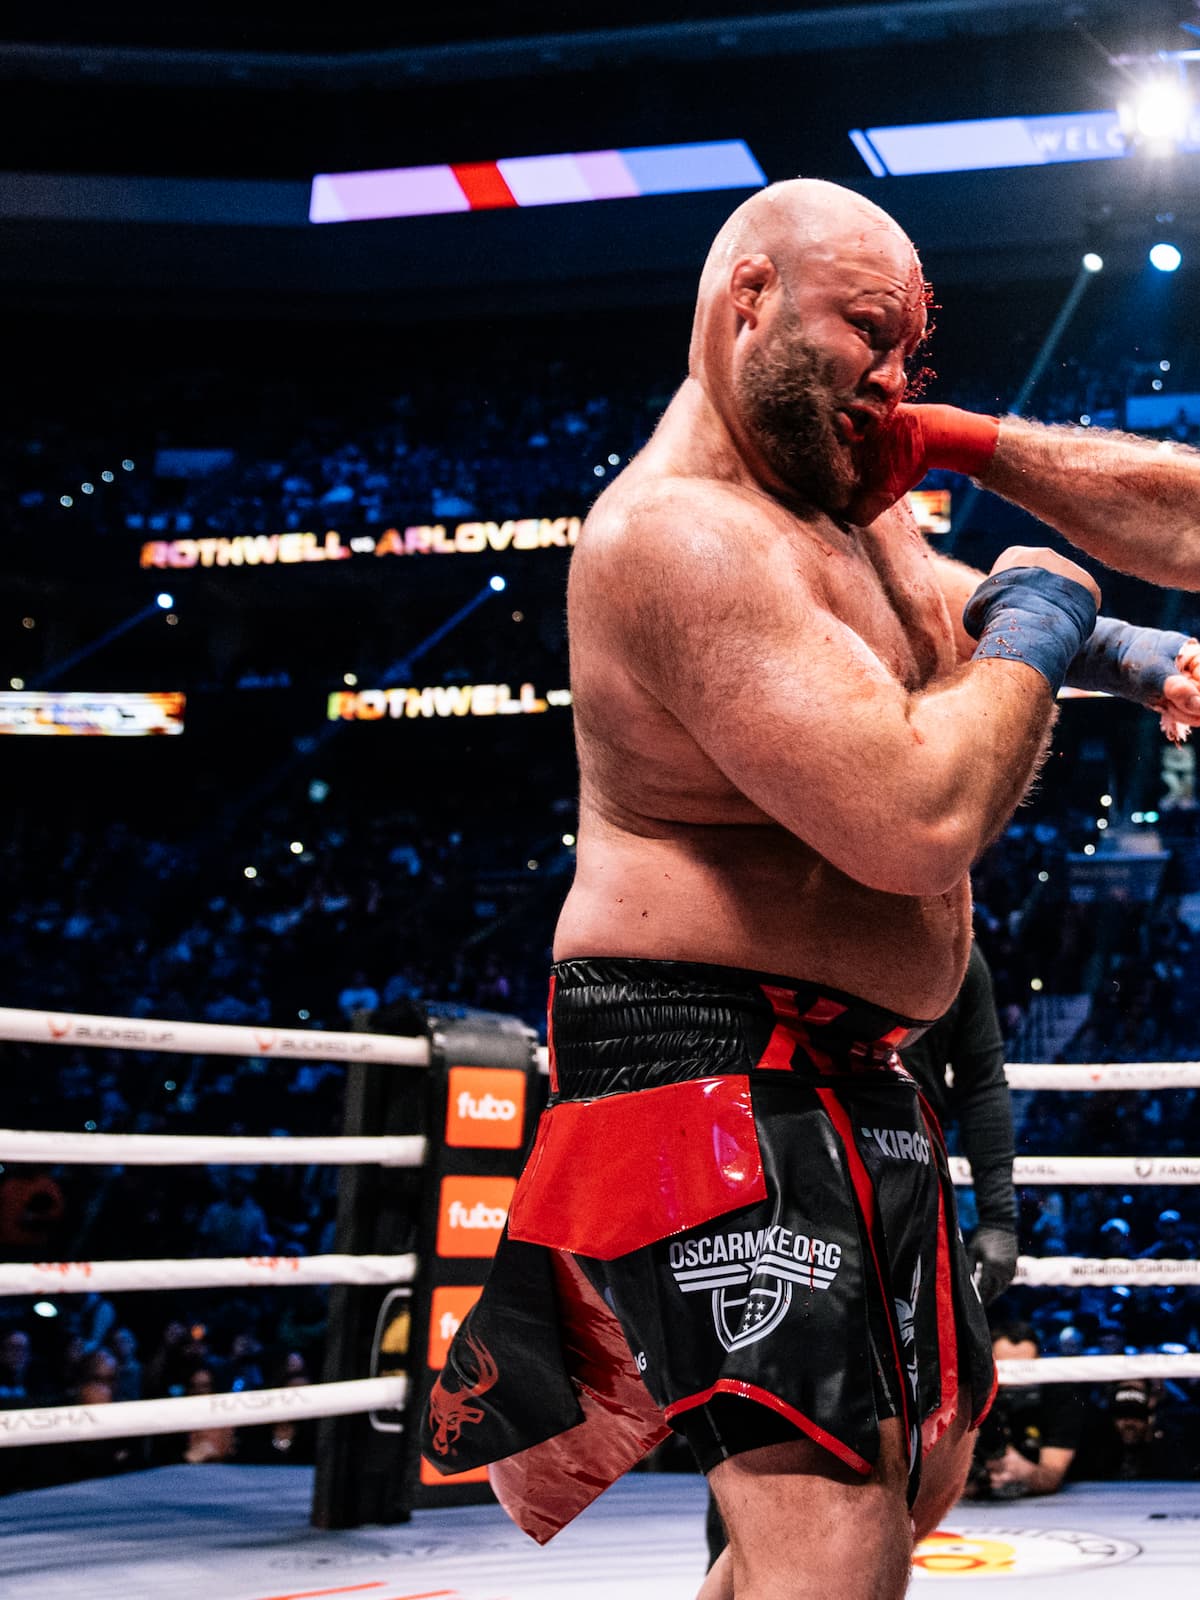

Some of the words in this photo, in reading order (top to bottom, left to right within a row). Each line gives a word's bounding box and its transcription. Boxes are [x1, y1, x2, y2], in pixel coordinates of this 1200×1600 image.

[140, 530, 350, 568] ROTHWELL
[327, 683, 548, 720] ROTHWELL
[457, 1091, 516, 1121] fubo
[669, 1224, 842, 1270] OSCARMKE.ORG
